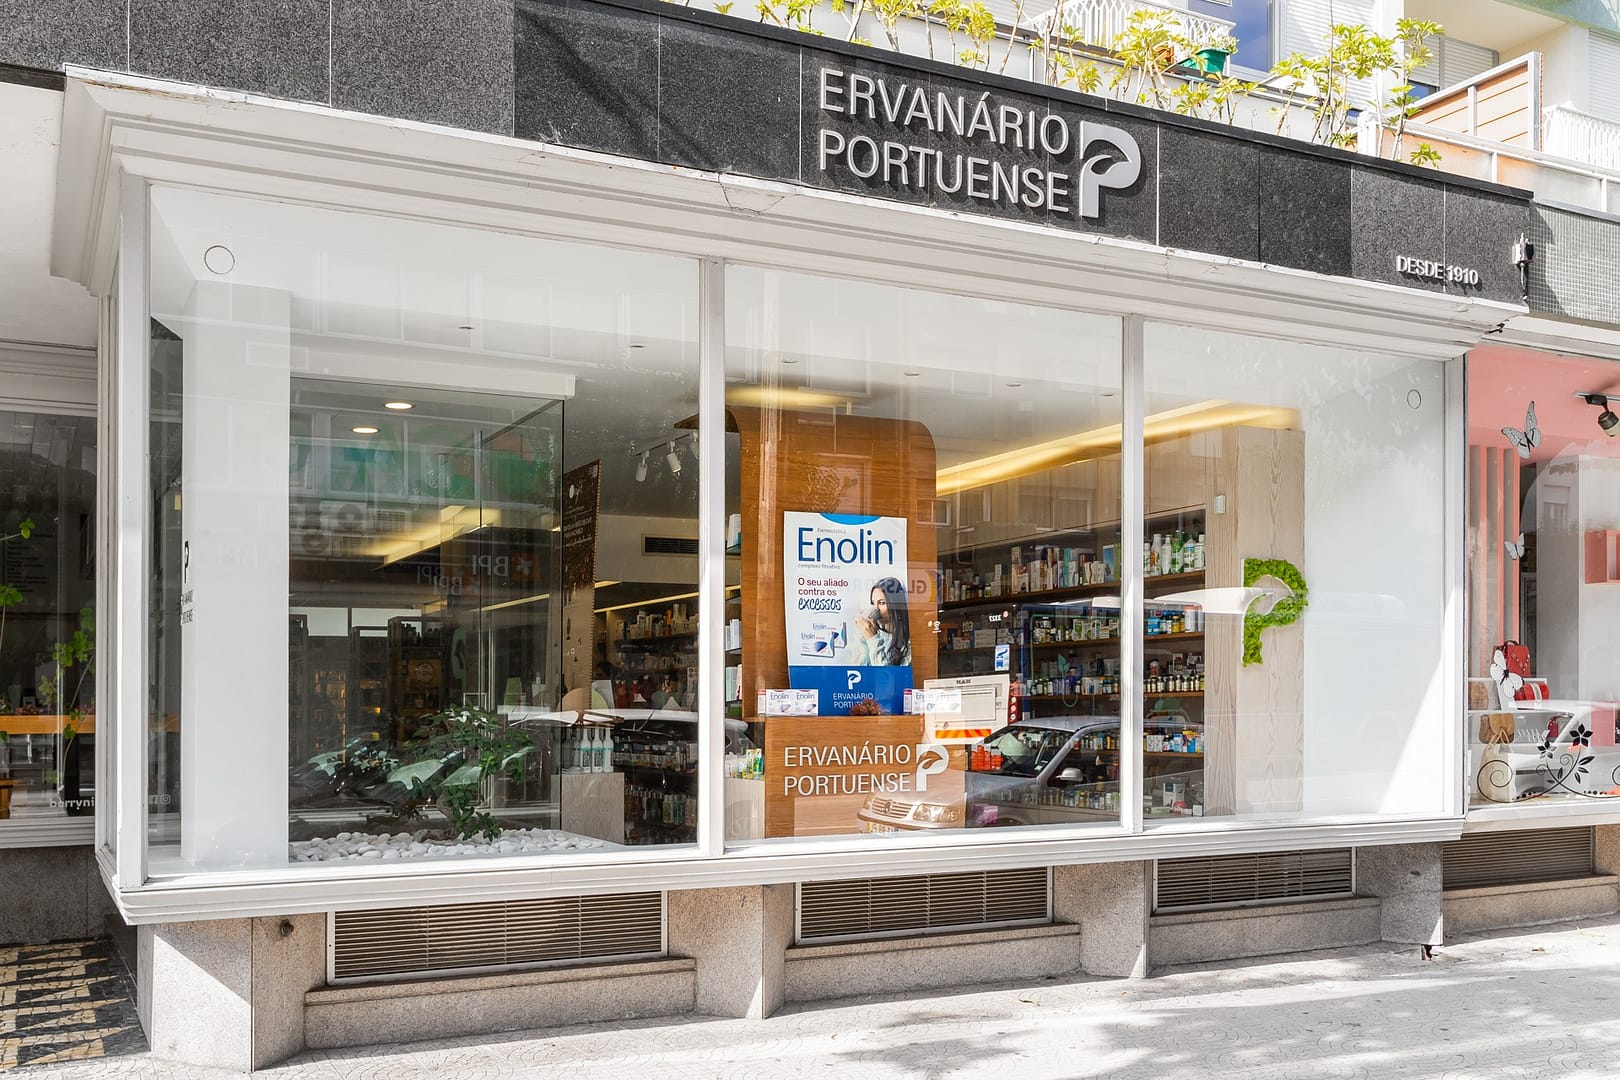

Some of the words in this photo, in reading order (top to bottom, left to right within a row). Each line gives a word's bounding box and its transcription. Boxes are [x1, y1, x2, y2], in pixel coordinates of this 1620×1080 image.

[820, 67, 1069, 155] ERVANÁRIO
[820, 129, 1069, 212] PORTUENSE
[1396, 255, 1444, 279] DESDE
[1446, 265, 1479, 285] 1910
[798, 527, 893, 565] Enolin
[798, 577, 805, 586] O
[807, 579, 822, 587] seu
[823, 579, 849, 588] aliado
[798, 588, 825, 596] contra
[827, 589, 837, 597] os
[798, 598, 841, 611] excessos
[770, 692, 789, 701] Enolin
[796, 692, 815, 701] Enolin
[832, 691, 874, 701] ERVANÁRIO
[784, 741, 911, 767] ERVANÁRIO
[784, 772, 911, 796] PORTUENSE
